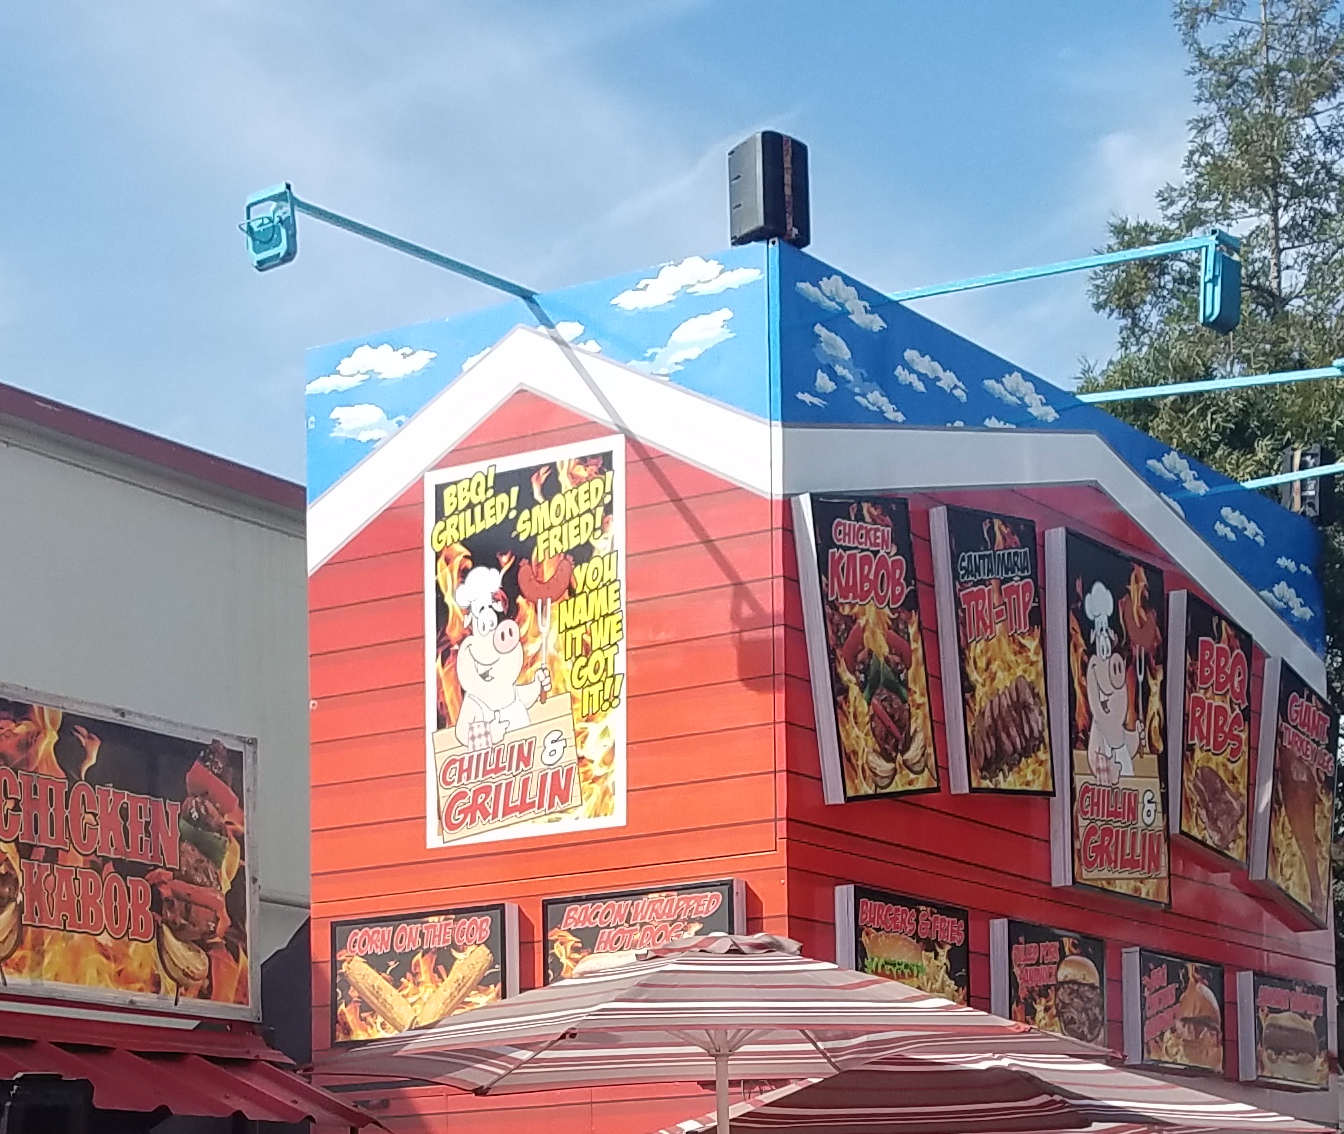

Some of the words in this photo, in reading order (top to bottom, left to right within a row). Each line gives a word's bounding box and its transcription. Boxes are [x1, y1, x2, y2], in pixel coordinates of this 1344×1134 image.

[443, 464, 496, 517] BBQ!
[514, 470, 615, 542] SMOKED!
[431, 486, 519, 552] GRILLED!
[536, 506, 604, 563] FRIED!
[832, 518, 891, 550] CHICKEN
[573, 550, 618, 594] YOU
[828, 549, 906, 608] KABOB
[958, 550, 995, 581] SANTA
[995, 548, 1031, 578] MARIA
[558, 579, 622, 634] NAME
[960, 578, 1034, 643] TRI-TIP
[565, 623, 586, 661] IT
[590, 610, 623, 649] WE
[571, 643, 619, 690] GOT
[1198, 636, 1249, 708] BBQ
[582, 673, 624, 717] IT!!
[1287, 692, 1330, 744] GIANT
[1188, 693, 1245, 762] RIBS
[439, 737, 536, 789] CHILLIN
[542, 730, 567, 766] &
[442, 765, 578, 834] GRILLIN
[1079, 782, 1138, 824] CHILLIN
[1141, 790, 1156, 826] &
[1081, 824, 1163, 877] GRILLIN
[20, 859, 155, 942] KABOB
[561, 900, 632, 930] BACON
[633, 891, 722, 923] WRAPPED
[858, 898, 916, 937] BURGERS
[917, 911, 932, 939] &
[931, 913, 965, 947] FRIES
[346, 925, 392, 956] CORN
[393, 923, 419, 952] ON
[420, 919, 454, 948] THE
[454, 916, 491, 946] COB
[594, 925, 637, 953] HOT
[634, 923, 682, 949] DOG
